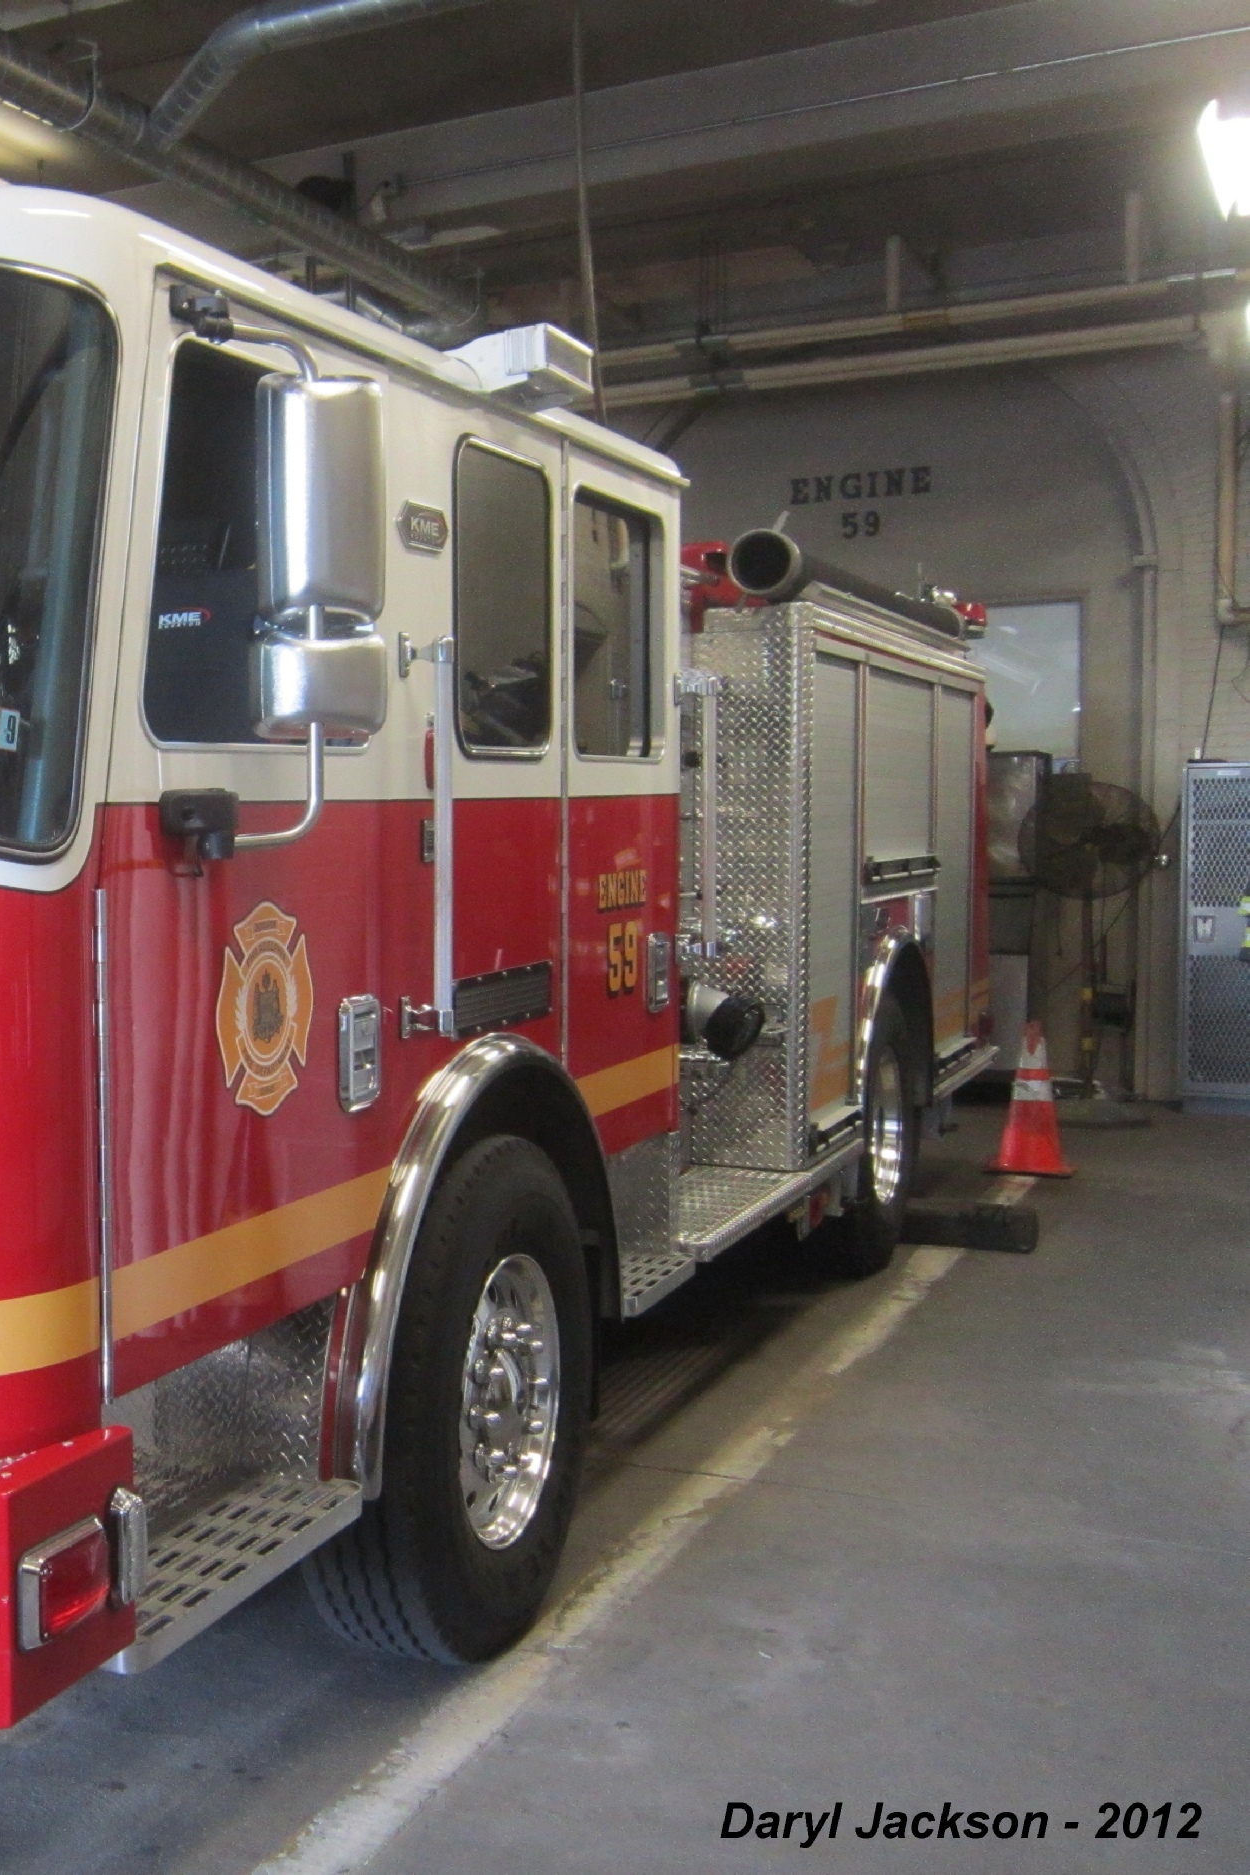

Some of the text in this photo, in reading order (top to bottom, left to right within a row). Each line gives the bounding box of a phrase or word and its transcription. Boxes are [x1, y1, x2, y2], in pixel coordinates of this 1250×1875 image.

[790, 466, 931, 505] ENGINE
[410, 516, 440, 537] KME
[841, 510, 880, 539] 59
[158, 611, 201, 626] KME
[6, 714, 17, 745] 9
[598, 869, 646, 911] ENGINE
[608, 920, 638, 997] 59
